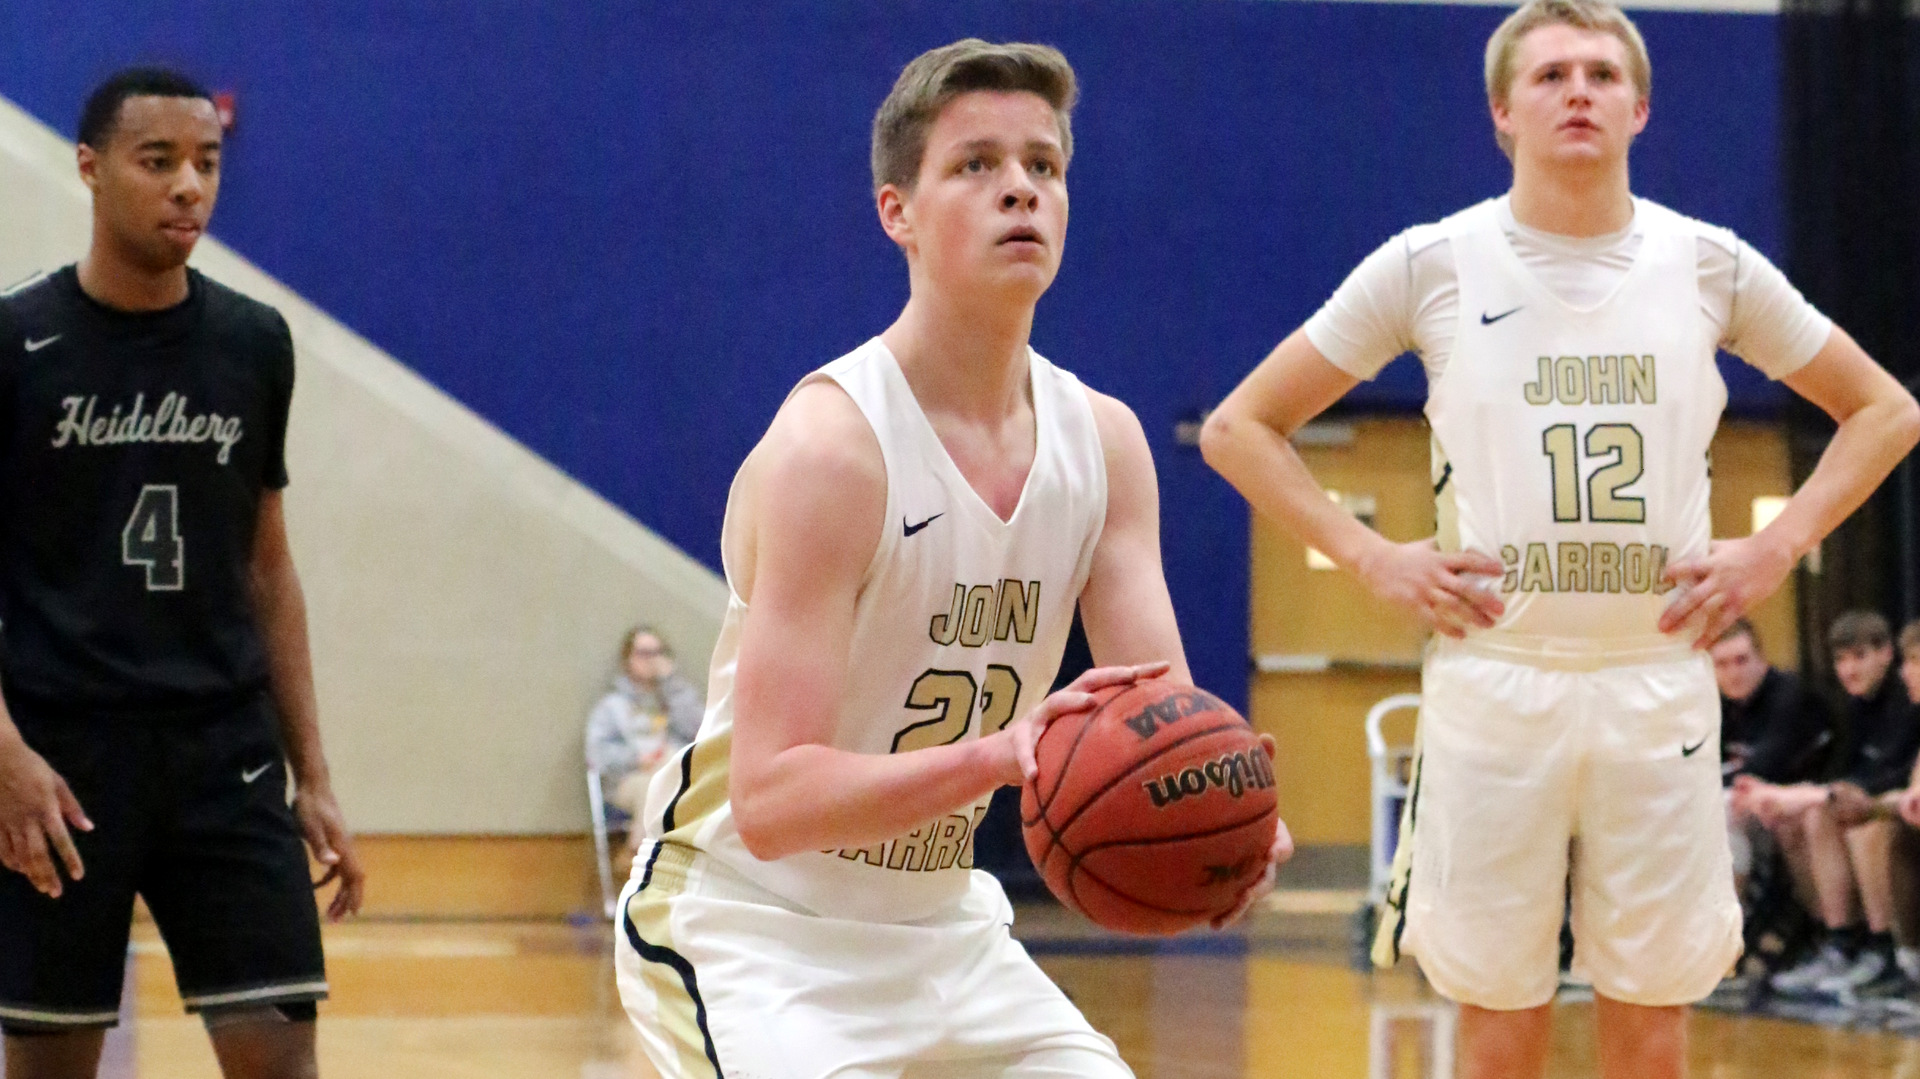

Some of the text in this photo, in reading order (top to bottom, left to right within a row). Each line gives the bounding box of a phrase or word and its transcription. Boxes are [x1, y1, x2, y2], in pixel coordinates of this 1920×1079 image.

[1523, 355, 1657, 405] JOHN
[51, 391, 243, 465] Heidelberg
[1542, 423, 1646, 524] 12
[122, 484, 184, 591] 4
[929, 578, 1041, 648] JON
